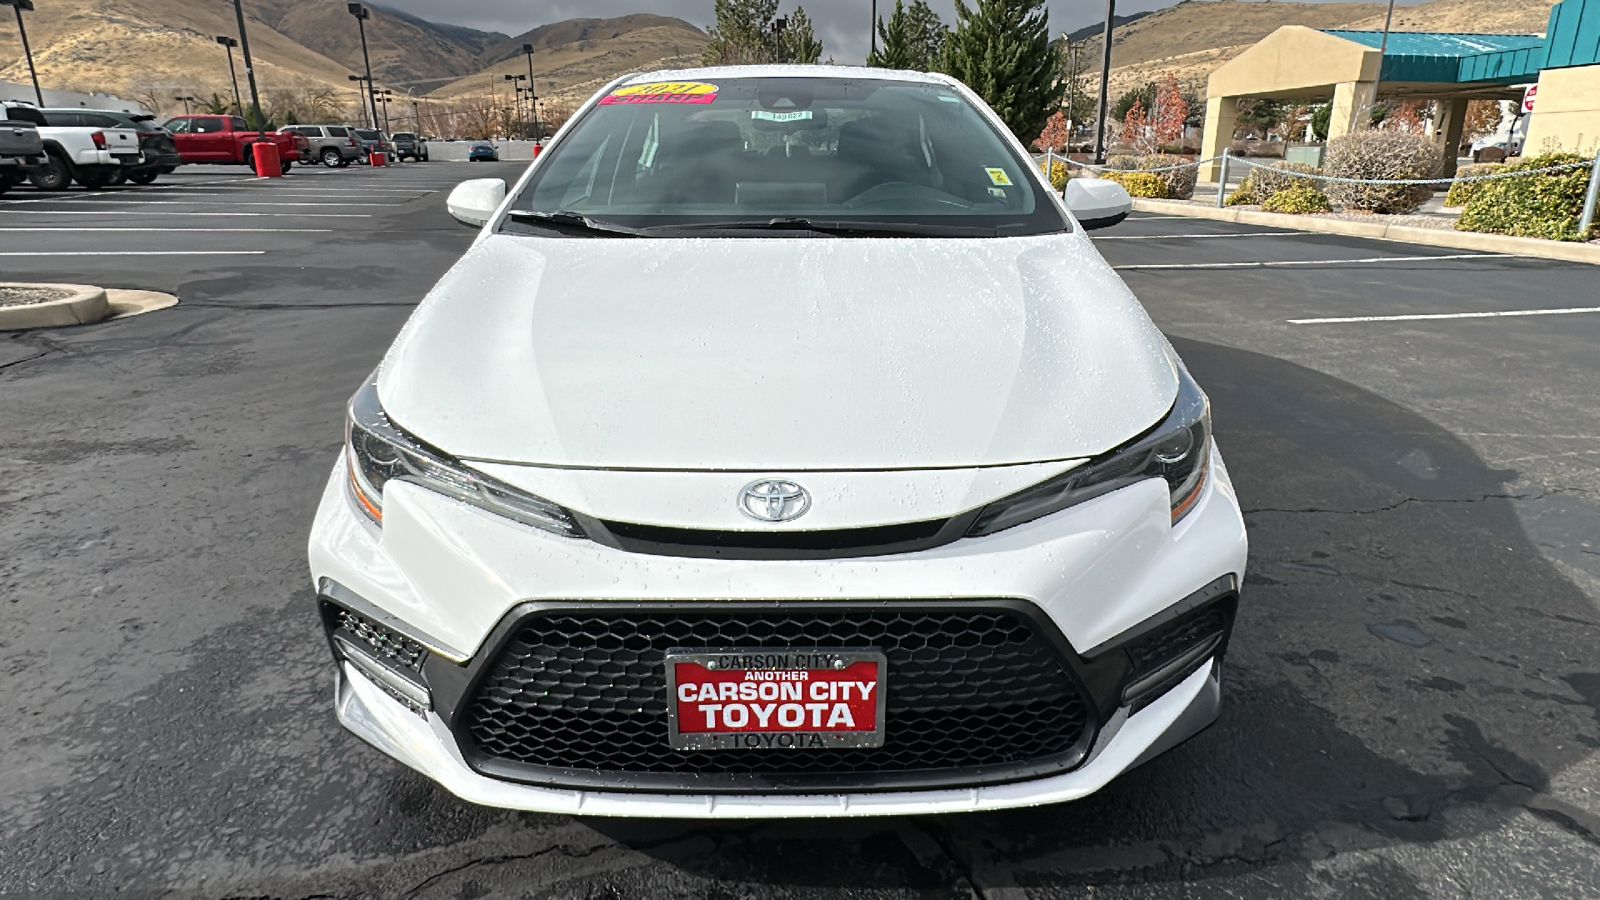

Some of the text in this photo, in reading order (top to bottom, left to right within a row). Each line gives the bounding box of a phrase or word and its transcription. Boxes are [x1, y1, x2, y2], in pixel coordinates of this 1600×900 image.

[611, 93, 706, 103] SHARP
[718, 654, 834, 669] CARSON CITY
[744, 671, 809, 681] ANOTHER
[677, 681, 876, 702] CARSON CITY
[698, 702, 856, 729] TOYOTA
[730, 732, 825, 748] TOYOTA
